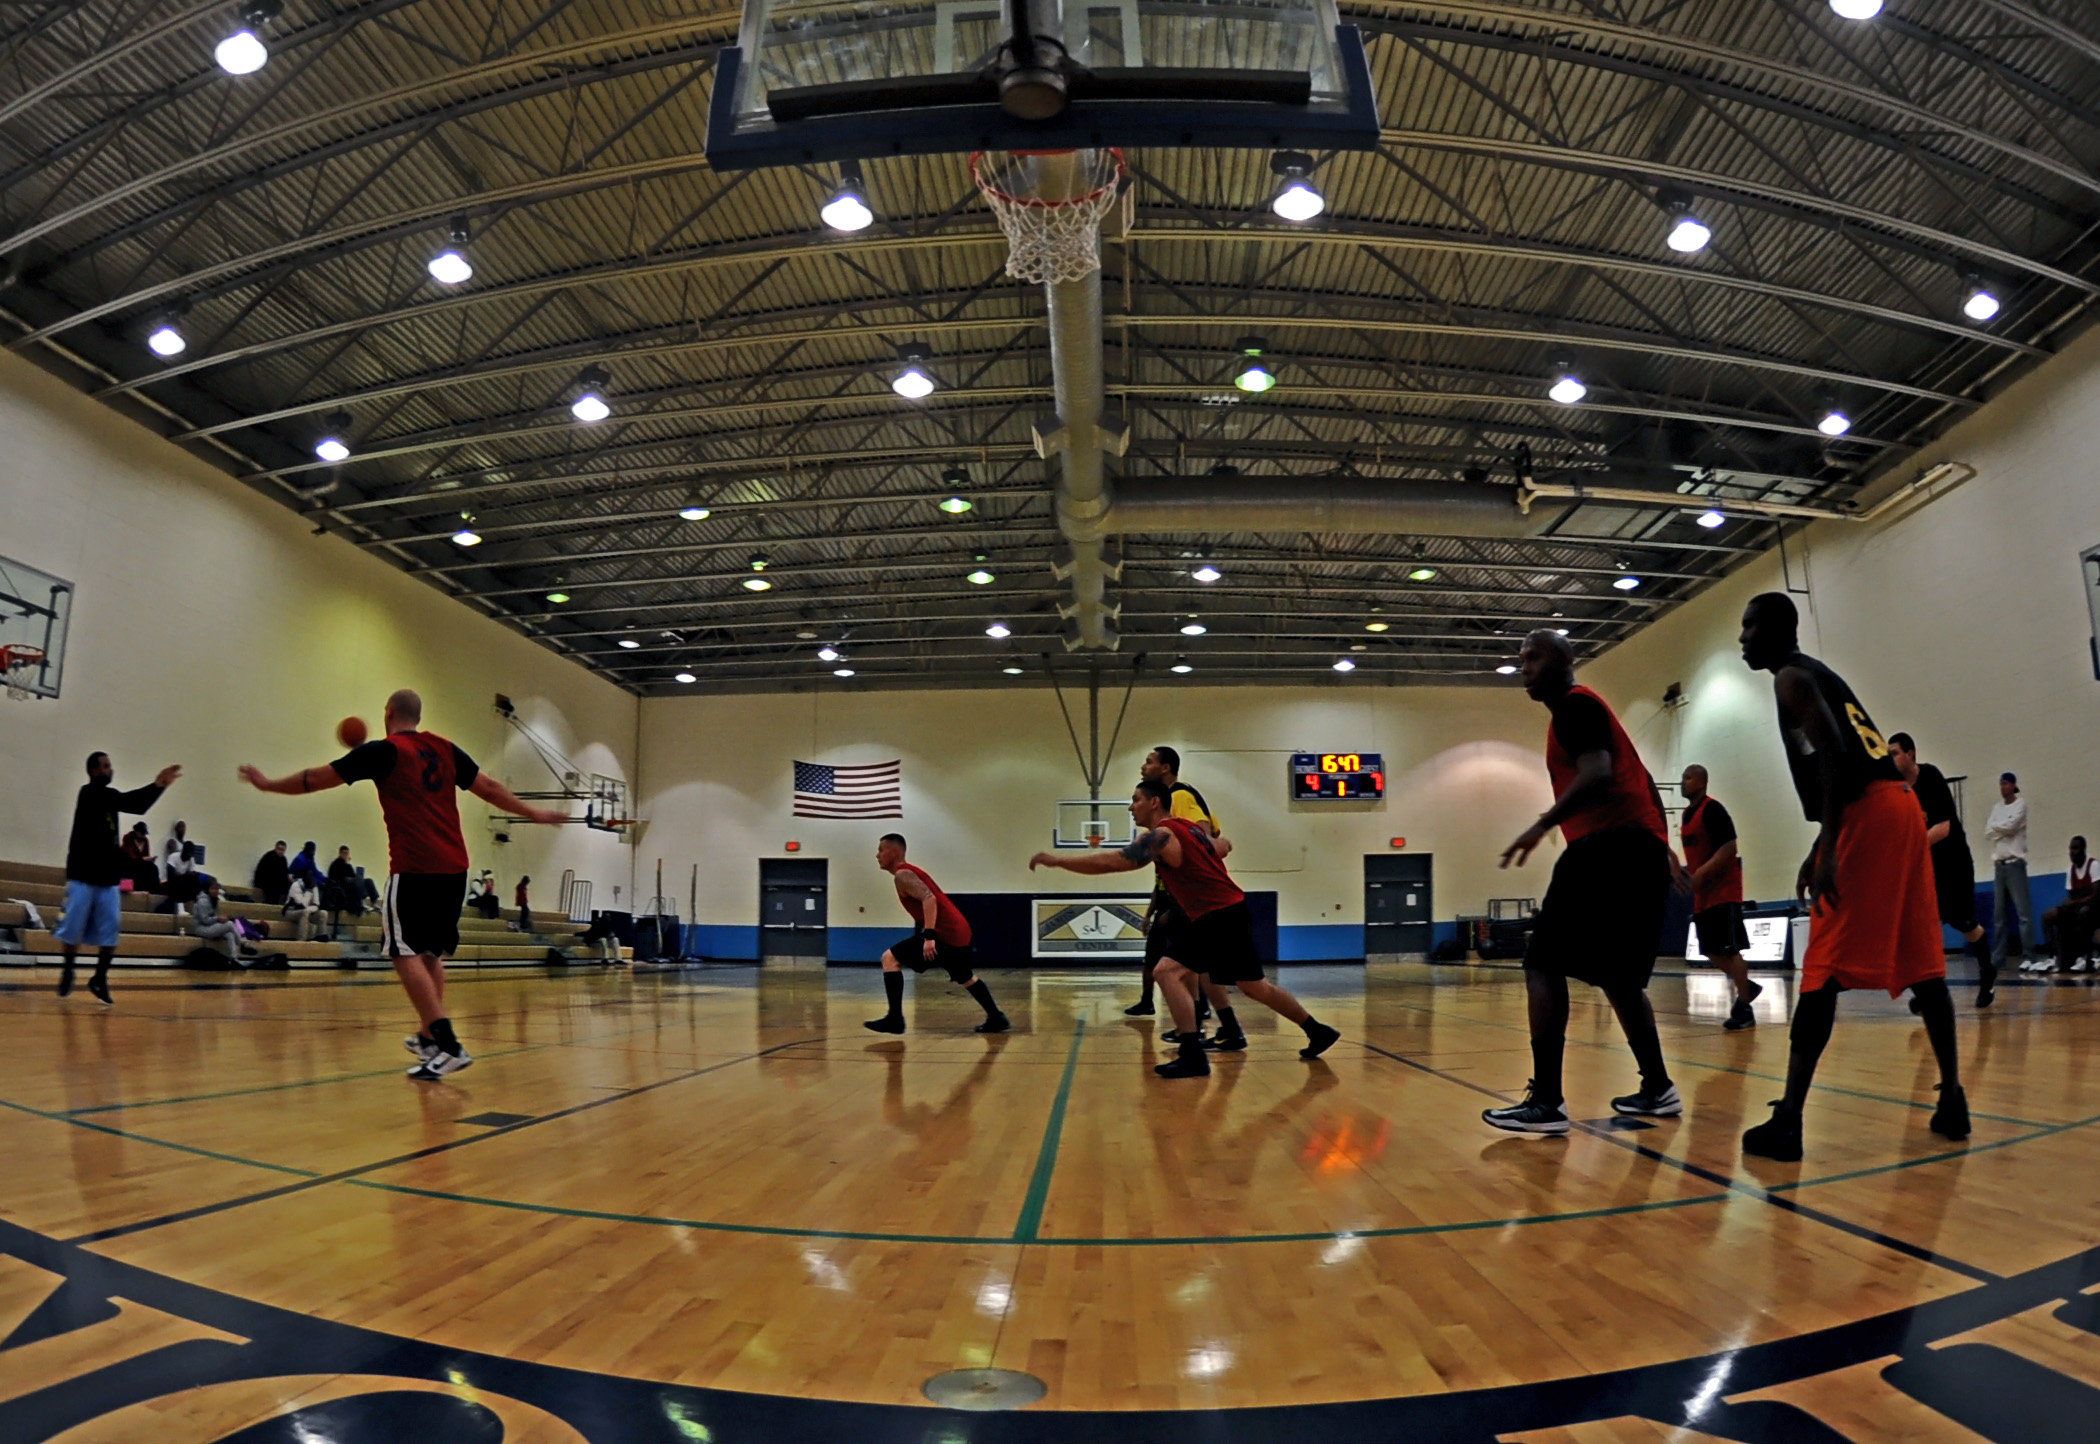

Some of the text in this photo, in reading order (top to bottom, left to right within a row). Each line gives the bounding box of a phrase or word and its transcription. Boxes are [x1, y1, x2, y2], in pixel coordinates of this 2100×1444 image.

[1845, 703, 1889, 760] 6
[1305, 772, 1383, 791] 4 7
[1338, 780, 1346, 797] 1
